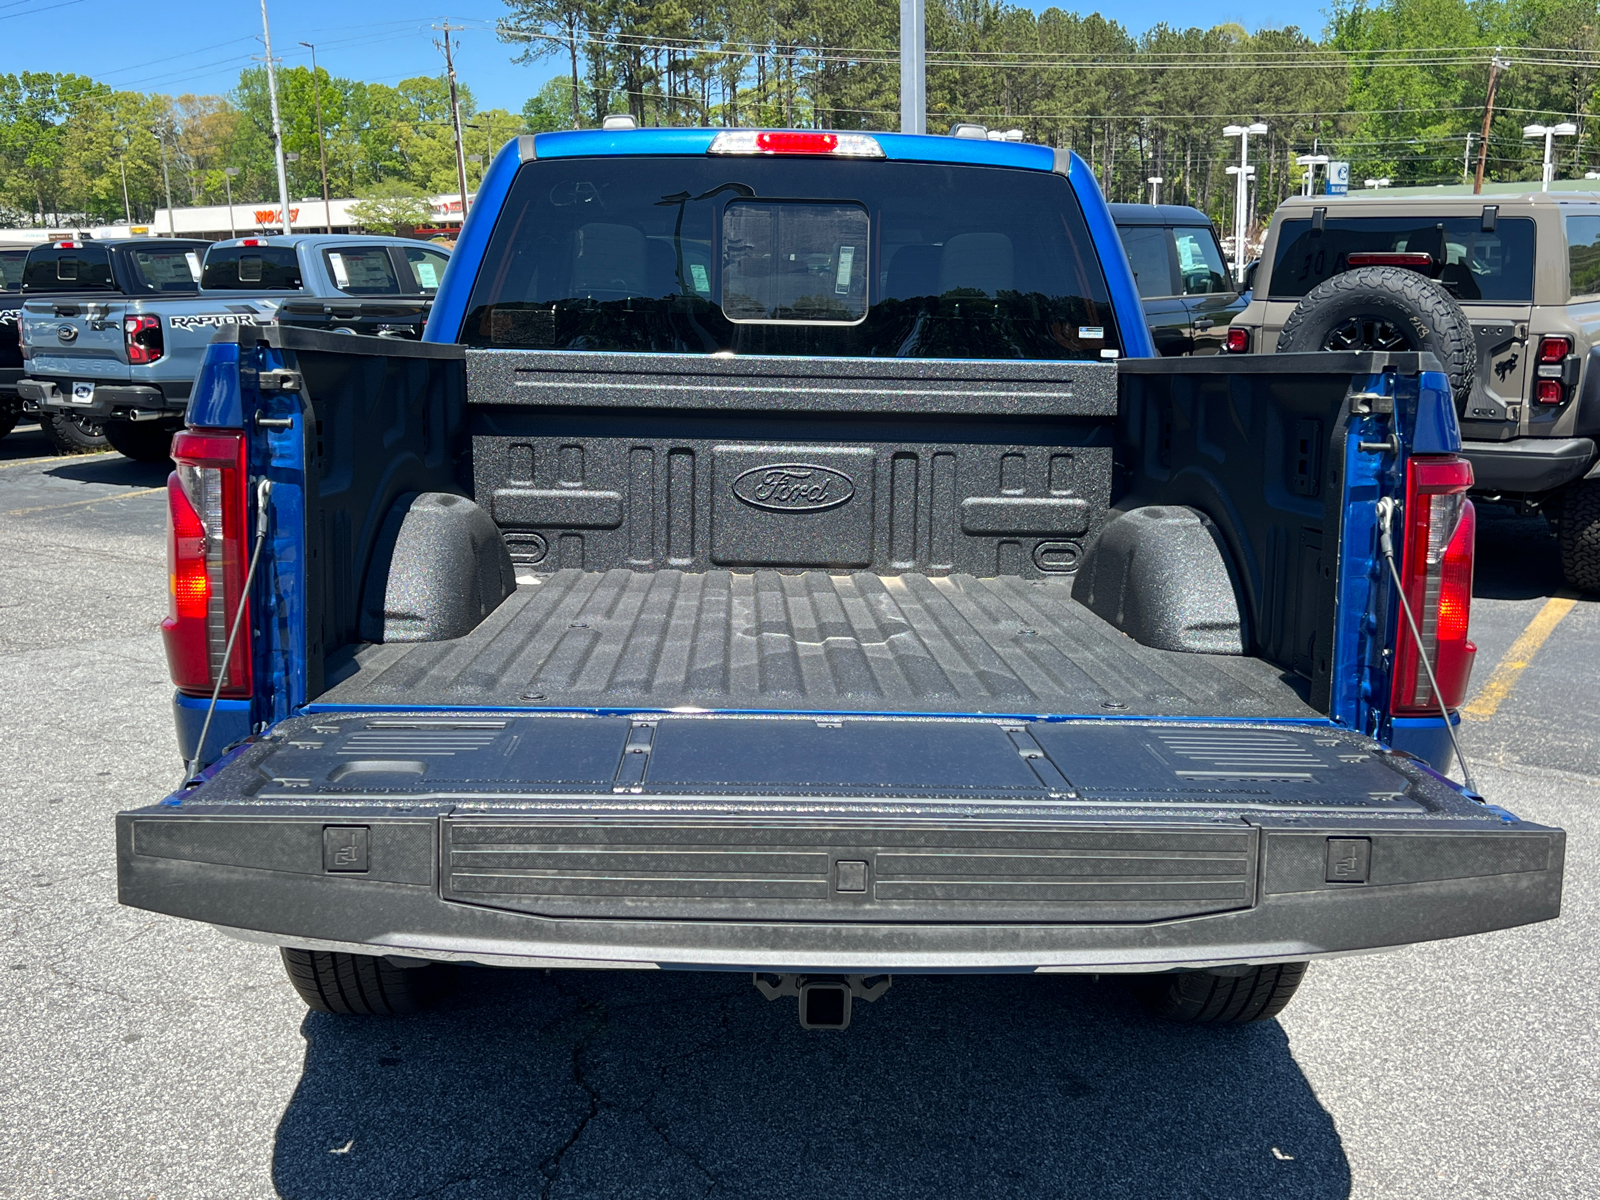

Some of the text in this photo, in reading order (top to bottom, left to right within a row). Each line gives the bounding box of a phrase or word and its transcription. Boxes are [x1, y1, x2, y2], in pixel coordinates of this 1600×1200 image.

[255, 210, 275, 224] BIG
[169, 313, 256, 332] RAPTOR
[755, 469, 831, 502] Ford
